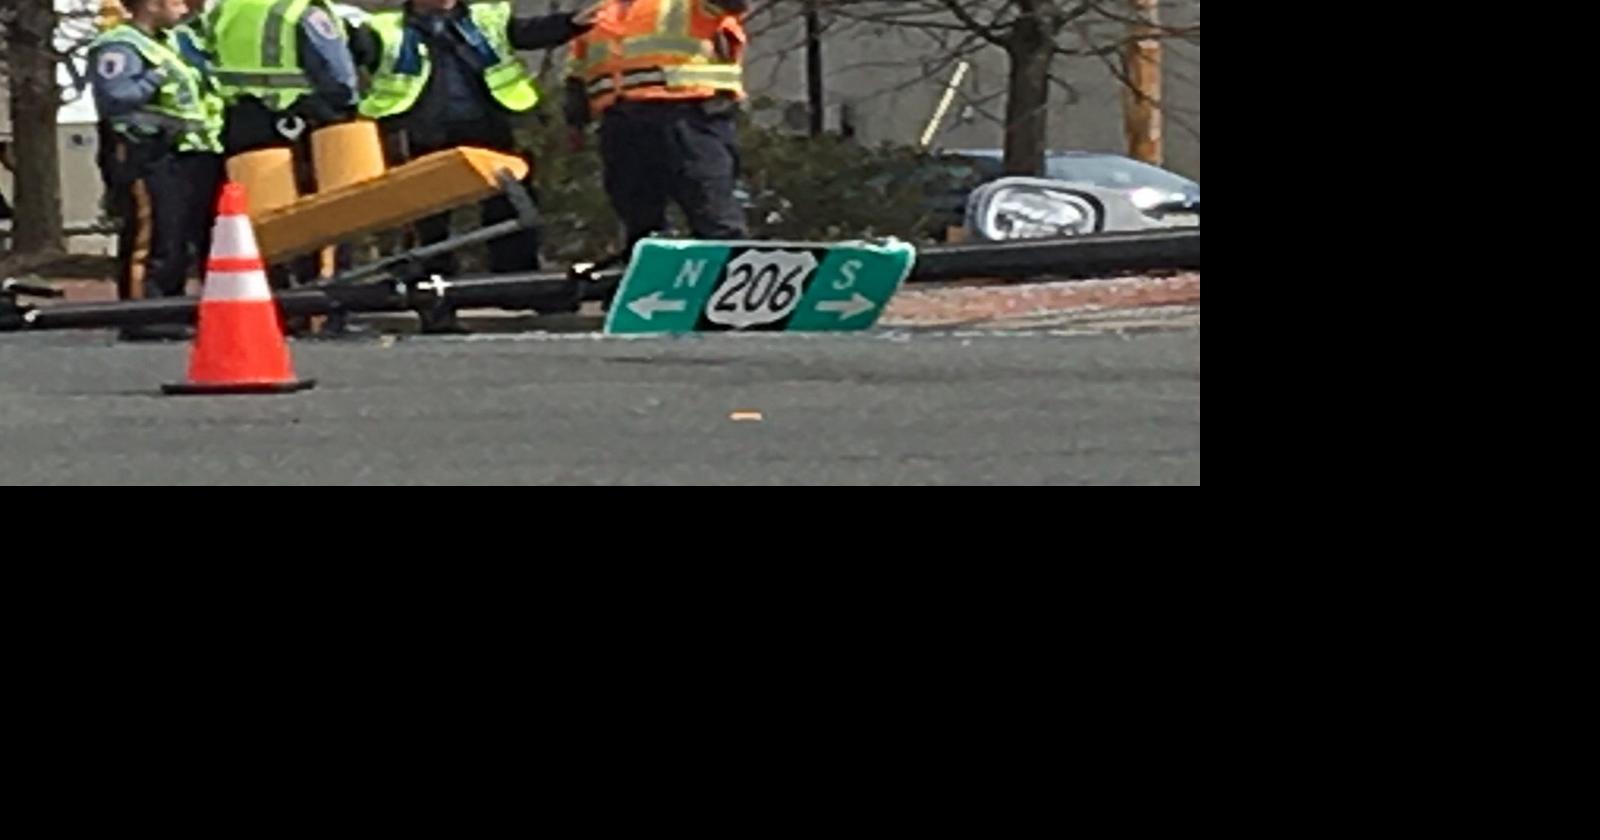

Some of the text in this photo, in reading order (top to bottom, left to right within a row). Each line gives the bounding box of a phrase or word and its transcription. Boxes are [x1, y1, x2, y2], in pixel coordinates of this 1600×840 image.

[673, 259, 863, 313] N 206 S
